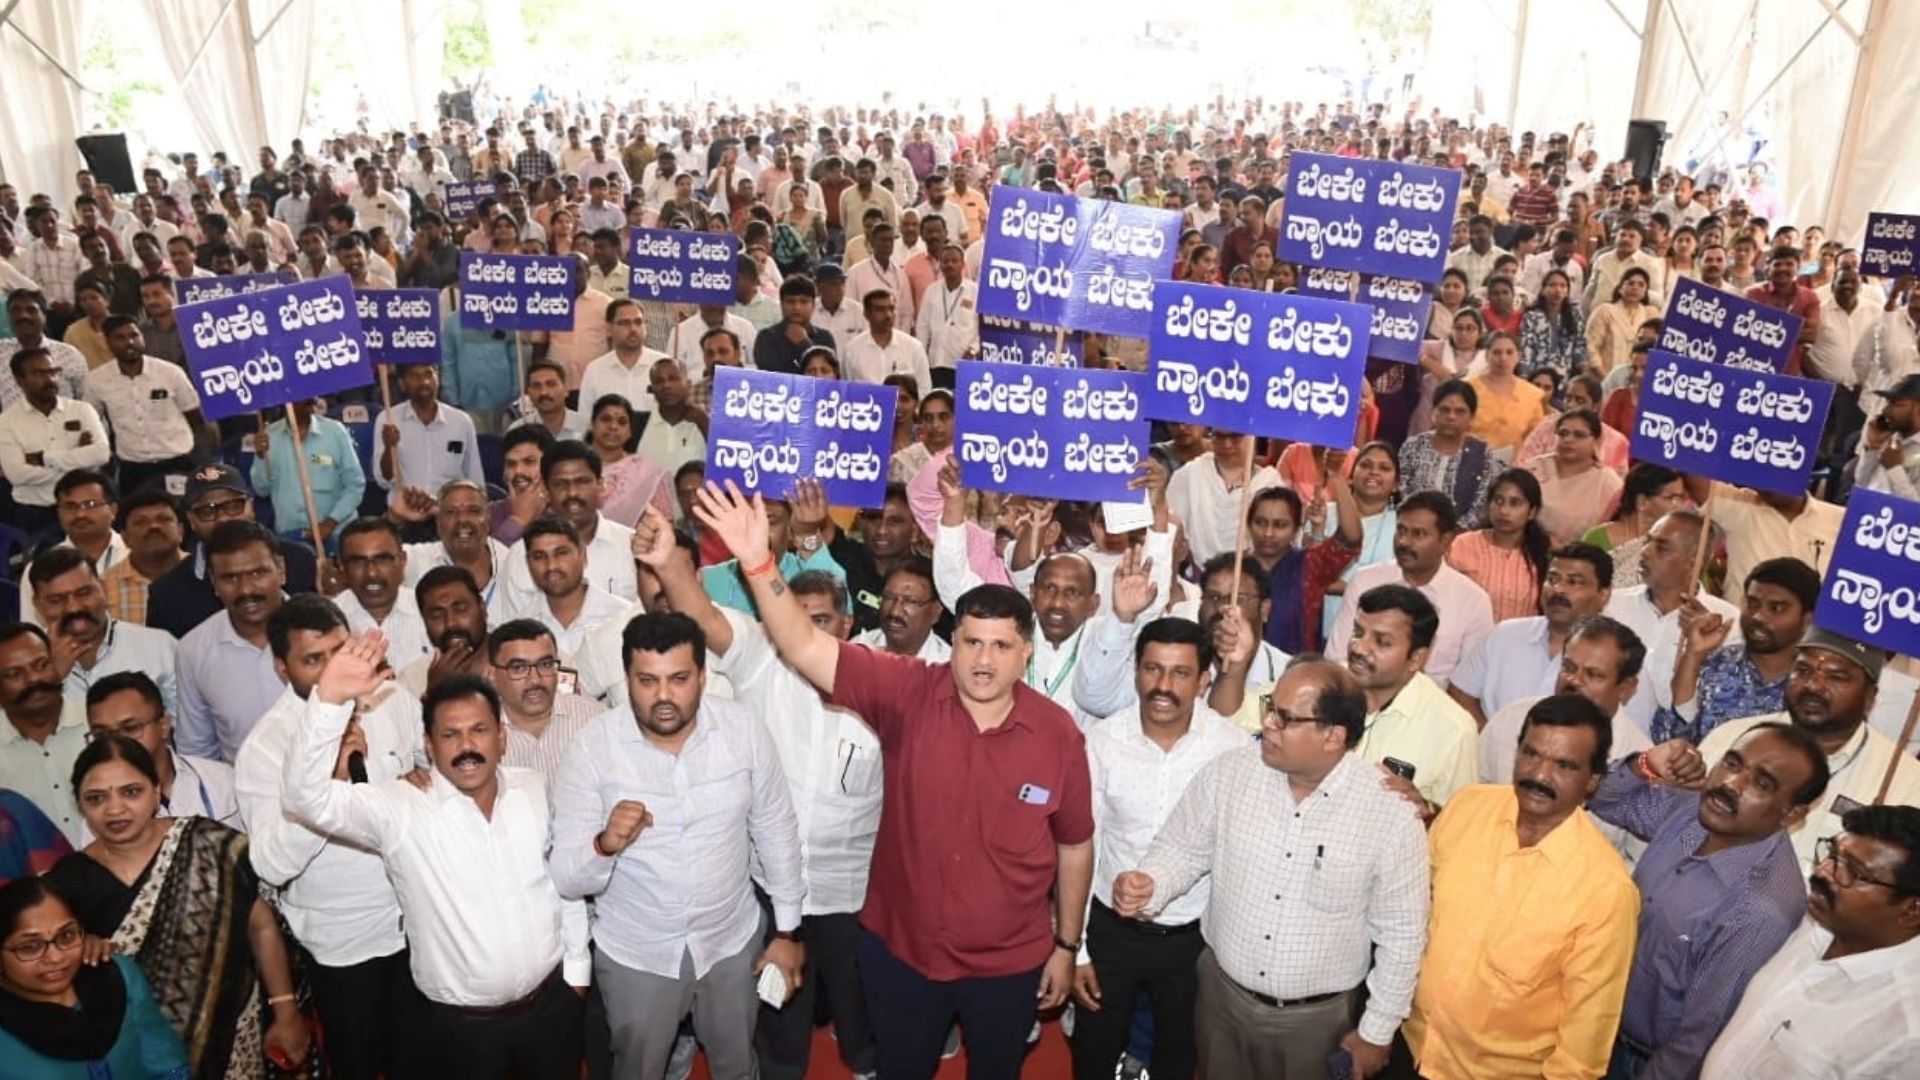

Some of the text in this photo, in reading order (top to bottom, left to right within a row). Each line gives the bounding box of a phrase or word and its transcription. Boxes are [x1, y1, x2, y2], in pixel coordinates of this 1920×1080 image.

[1297, 163, 1445, 212] ಬೇಕೇ ಬೇಕು
[637, 233, 730, 262] ಬೇಕೇ ಬೇಕು
[1001, 198, 1165, 258] ಬೇಕೇ ಬೇಕು
[1286, 214, 1440, 260] ನ್ಯಾಯ ಬೇಕು
[1872, 218, 1916, 240] ಬೇಕೇ
[468, 257, 568, 285] ಬೇಕೇ ಬೇಕು
[633, 264, 732, 296] ನ್ಯಾಯ ಬೇಕು
[989, 258, 1073, 311] ನ್ಯಾಯ
[1865, 245, 1913, 274] ನ್ಯಾಯ
[192, 288, 345, 349] ಬೇಕೇ ಬೇಕು
[386, 295, 432, 318] ಬೇಕು
[464, 290, 570, 324] ನ್ಯಾಯ ಬೇಕು
[1165, 294, 1352, 359] ಬೇಕೇ ಬೇಕು
[1677, 288, 1787, 348] ಬೇಕೇ ಬೇಕು
[392, 325, 437, 348] ಬೇಕು
[200, 331, 361, 405] ನ್ಯಾಯ ಬೇಕು
[1156, 358, 1349, 417] ನ್ಯಾಯ ಬೇಕು
[1652, 362, 1812, 423] ಬೇಕೇ ಬೇಕು
[724, 379, 882, 432] ಬೇಕೇ ಬೇಕು
[968, 372, 1138, 422] ಬೇಕೇ ಬೇಕು
[715, 436, 880, 488] ನ್ಯಾಯ ಬೇಕು
[961, 429, 1139, 483] ನ್ಯಾಯ ಬೇಕು
[1640, 411, 1805, 470] ನ್ಯಾಯ ಬೇಕು
